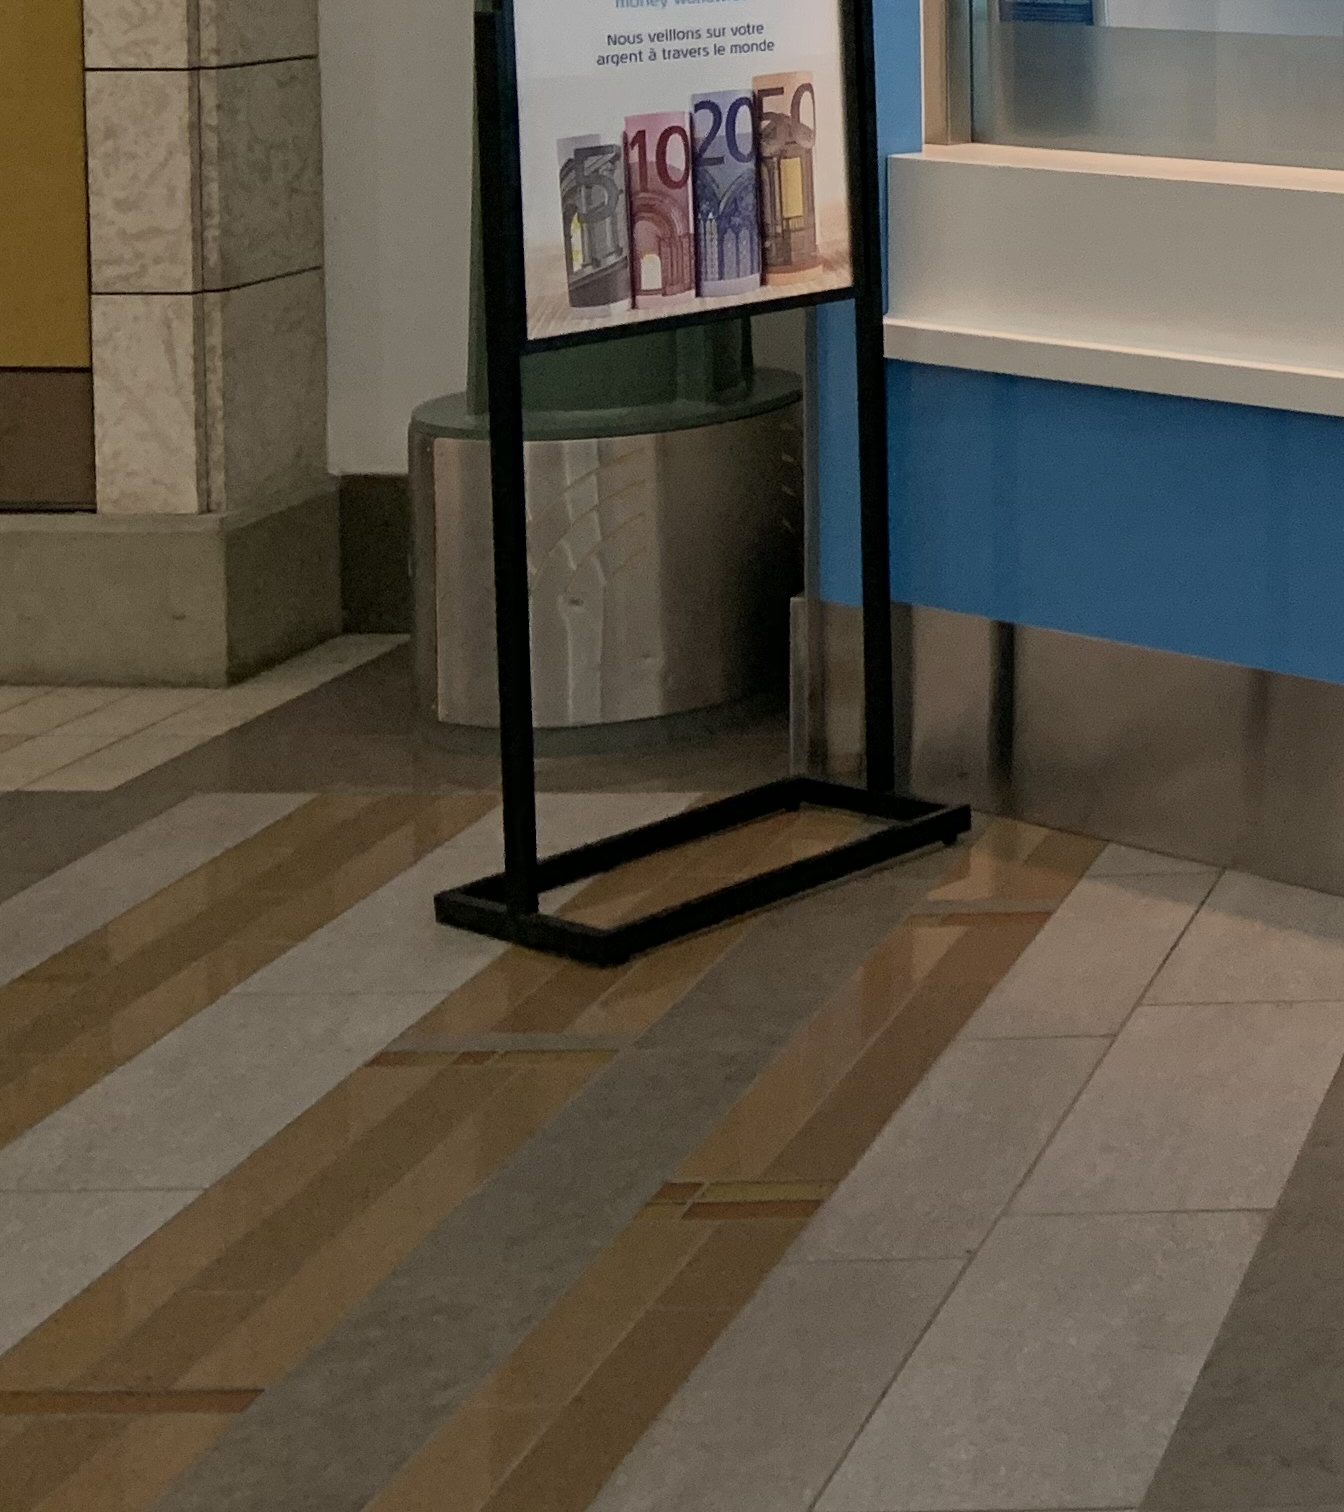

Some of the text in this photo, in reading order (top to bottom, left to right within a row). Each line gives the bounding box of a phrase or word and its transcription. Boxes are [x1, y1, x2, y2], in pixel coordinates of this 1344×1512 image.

[596, 40, 775, 67] argent à travers le monde
[607, 23, 764, 46] Nous veillons sur votre
[693, 96, 755, 167] 20
[629, 125, 691, 192] 10
